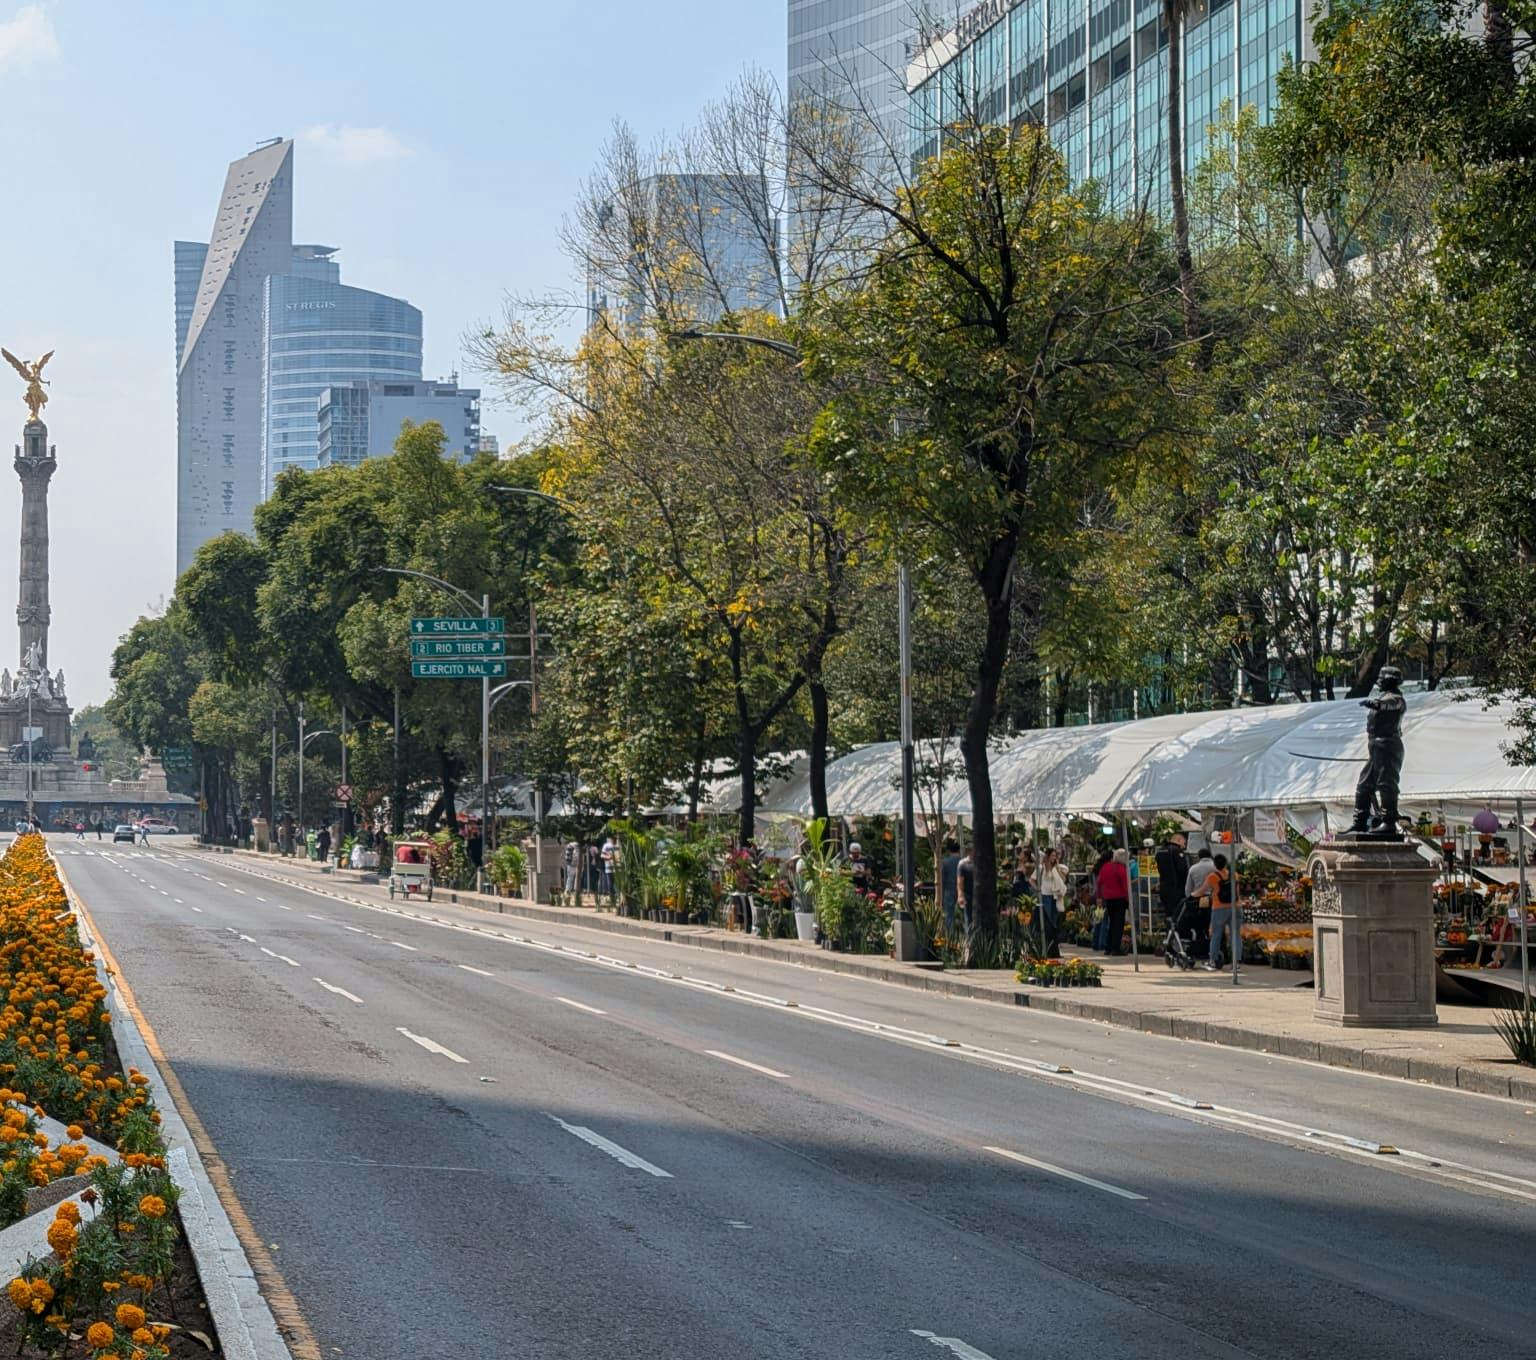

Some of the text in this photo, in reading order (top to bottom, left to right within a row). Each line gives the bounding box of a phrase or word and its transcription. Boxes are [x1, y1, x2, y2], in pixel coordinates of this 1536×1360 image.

[300, 300, 337, 310] REGIS
[433, 621, 479, 631] SEVILLA
[435, 643, 452, 653] RIO
[456, 642, 485, 653] TIBER
[419, 664, 488, 675] EJERCITO NAL
